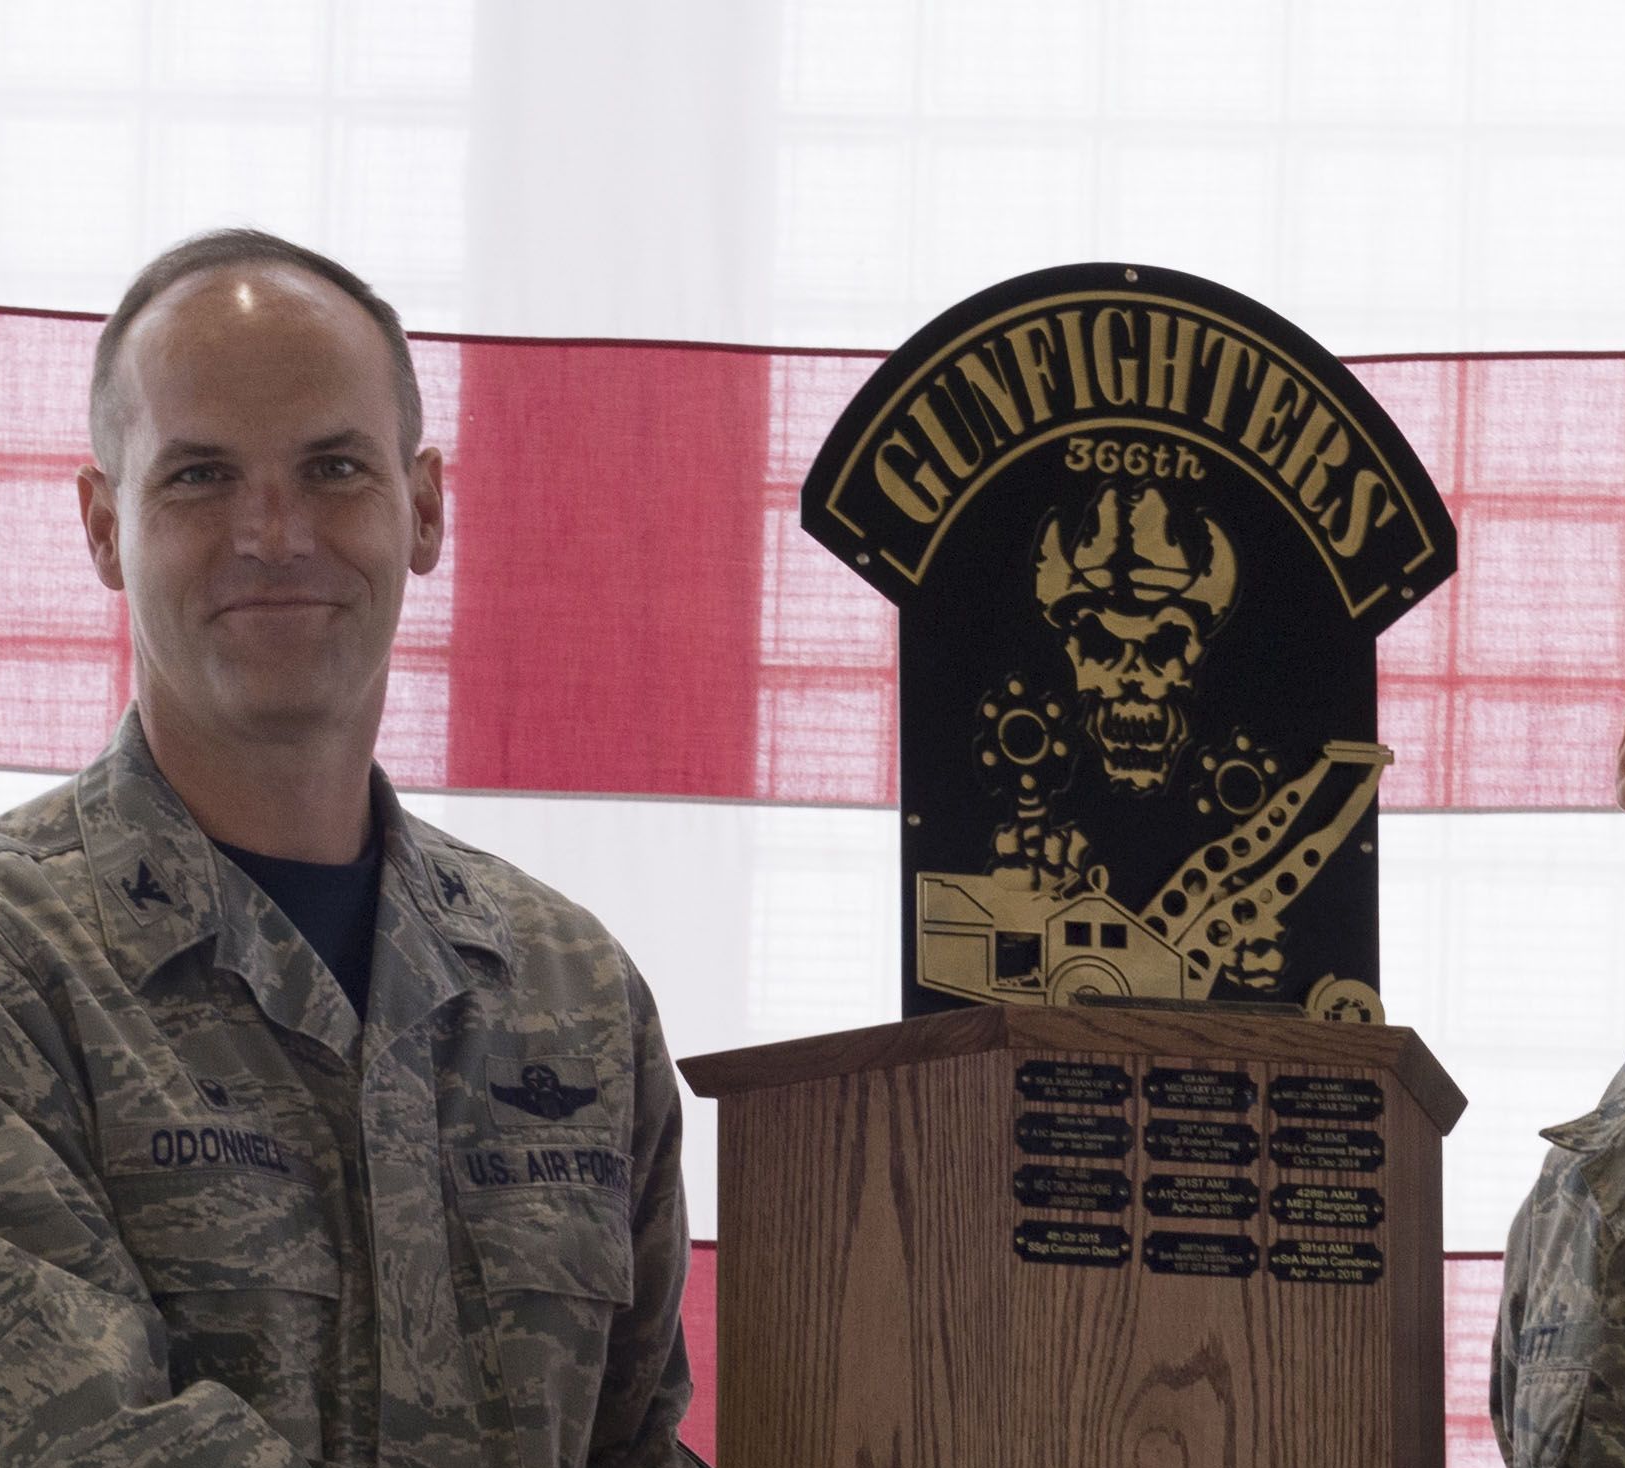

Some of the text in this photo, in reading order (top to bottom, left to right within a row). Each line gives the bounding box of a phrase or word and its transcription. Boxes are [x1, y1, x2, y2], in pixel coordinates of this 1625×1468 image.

[873, 306, 1400, 560] GUNFIGHTERS
[1064, 437, 1207, 480] 366th
[1197, 1075, 1219, 1084] AMU
[1324, 1083, 1344, 1092] AMU
[1167, 1094, 1186, 1103] OCT
[1198, 1126, 1223, 1137] AMU
[1324, 1132, 1348, 1143] EMS
[465, 1151, 518, 1186] U.S.
[526, 1150, 573, 1183] AIR
[1292, 1155, 1310, 1166] Oct
[1317, 1157, 1336, 1167] Dec
[1338, 1158, 1361, 1168] 2014
[1173, 1177, 1230, 1191] 391ST AMU
[1158, 1188, 1246, 1204] A1C Camden Nash
[1296, 1188, 1358, 1200] 428th AMU
[1286, 1198, 1312, 1209] ME2
[1288, 1209, 1304, 1220] Jul
[1313, 1210, 1337, 1223] Sep
[1339, 1212, 1367, 1223] 2015
[1298, 1242, 1354, 1255] 391st AMU
[1280, 1253, 1300, 1265] SrA
[1300, 1254, 1328, 1266] Nash
[1289, 1266, 1308, 1279] Apr
[1316, 1268, 1336, 1279] Jun
